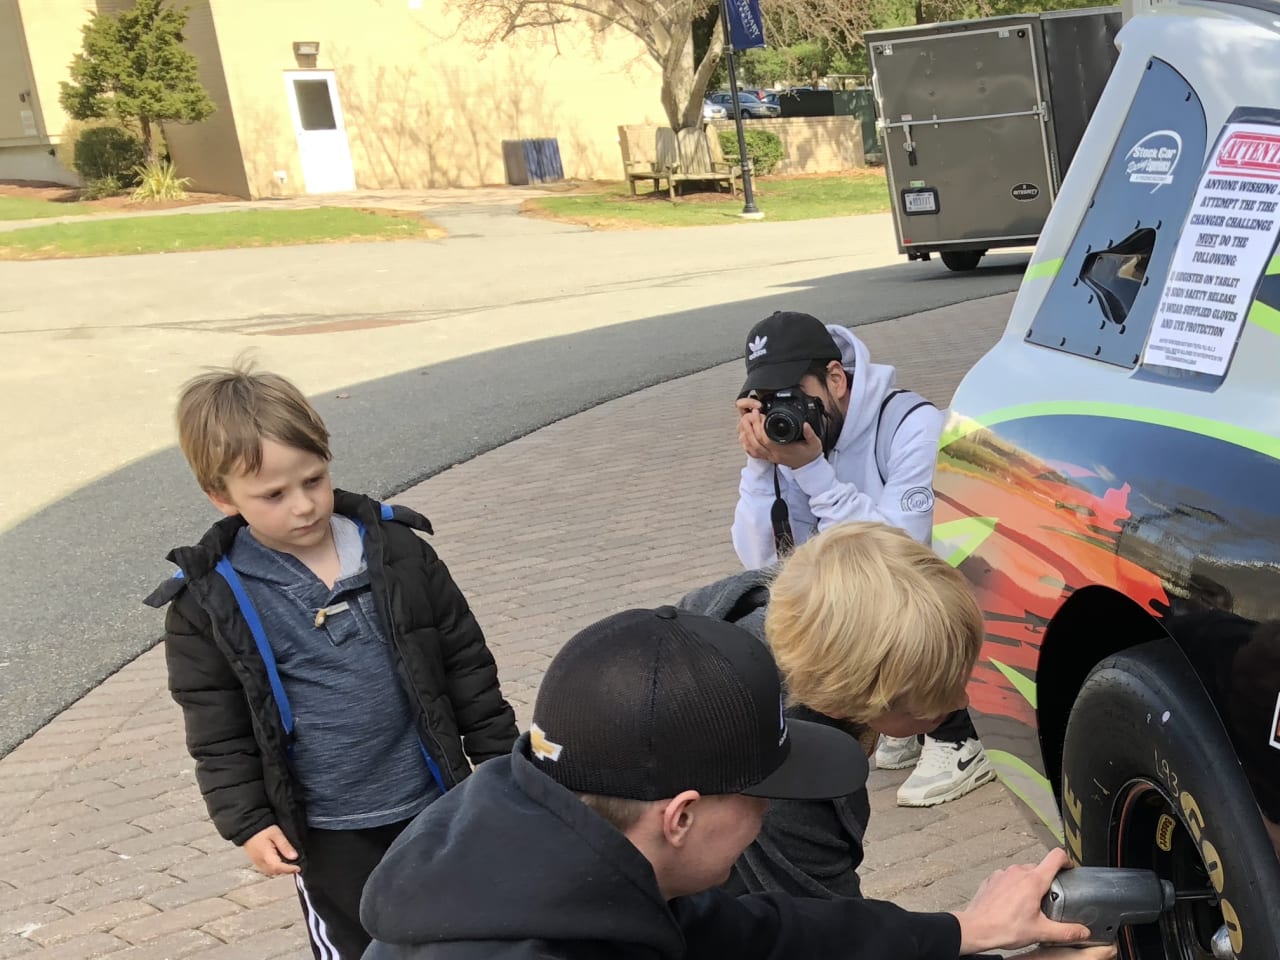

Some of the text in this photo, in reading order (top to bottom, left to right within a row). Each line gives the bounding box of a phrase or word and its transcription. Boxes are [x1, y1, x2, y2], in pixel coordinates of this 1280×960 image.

[1133, 146, 1176, 158] Stock Car
[1204, 178, 1238, 191] ANYONE
[1239, 181, 1277, 195] WISHING
[1200, 196, 1278, 213] ATTEMPT THE TIRE
[1190, 214, 1274, 231] CHANGER CHALLENGE
[1196, 233, 1249, 248] MUST DO THE
[1175, 272, 1204, 284] REGISTER
[1203, 274, 1214, 285] ON
[1214, 276, 1240, 288] TABLET
[1184, 289, 1208, 301] SAFETY
[1207, 291, 1237, 305] RELEASE
[1166, 303, 1183, 314] WEAR
[1183, 305, 1212, 318] SUPPLIED
[1212, 309, 1238, 322] GLOVES
[1161, 318, 1225, 337] AND EYE PROTECTION
